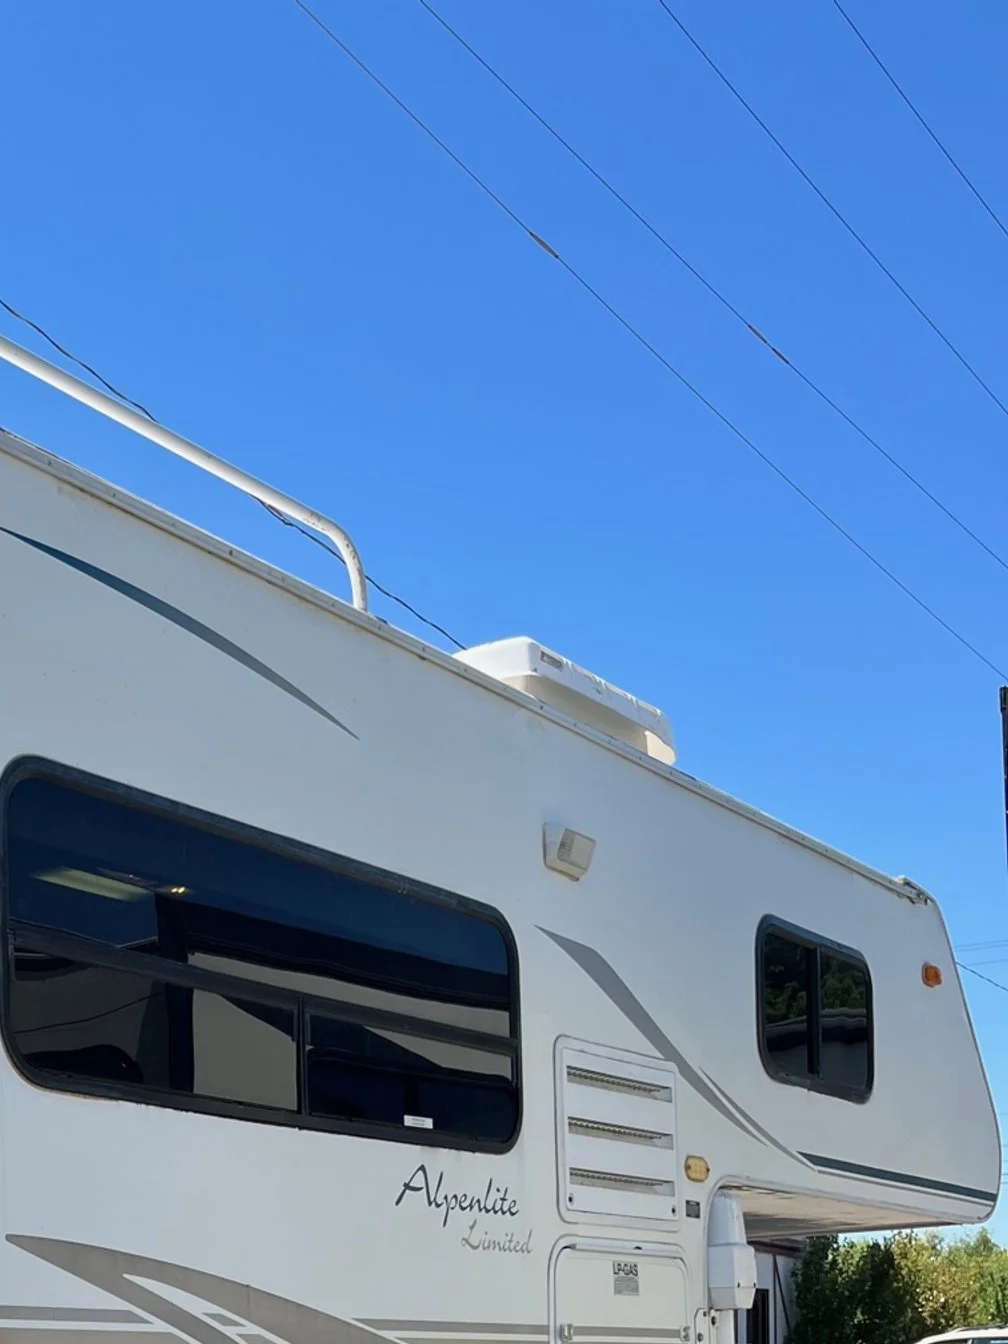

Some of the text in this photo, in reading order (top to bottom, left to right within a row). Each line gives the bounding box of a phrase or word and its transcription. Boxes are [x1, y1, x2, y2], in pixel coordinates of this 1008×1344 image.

[394, 1163, 520, 1228] Alpenlite
[461, 1218, 534, 1255] Limited
[612, 1261, 640, 1277] LP-GAS
